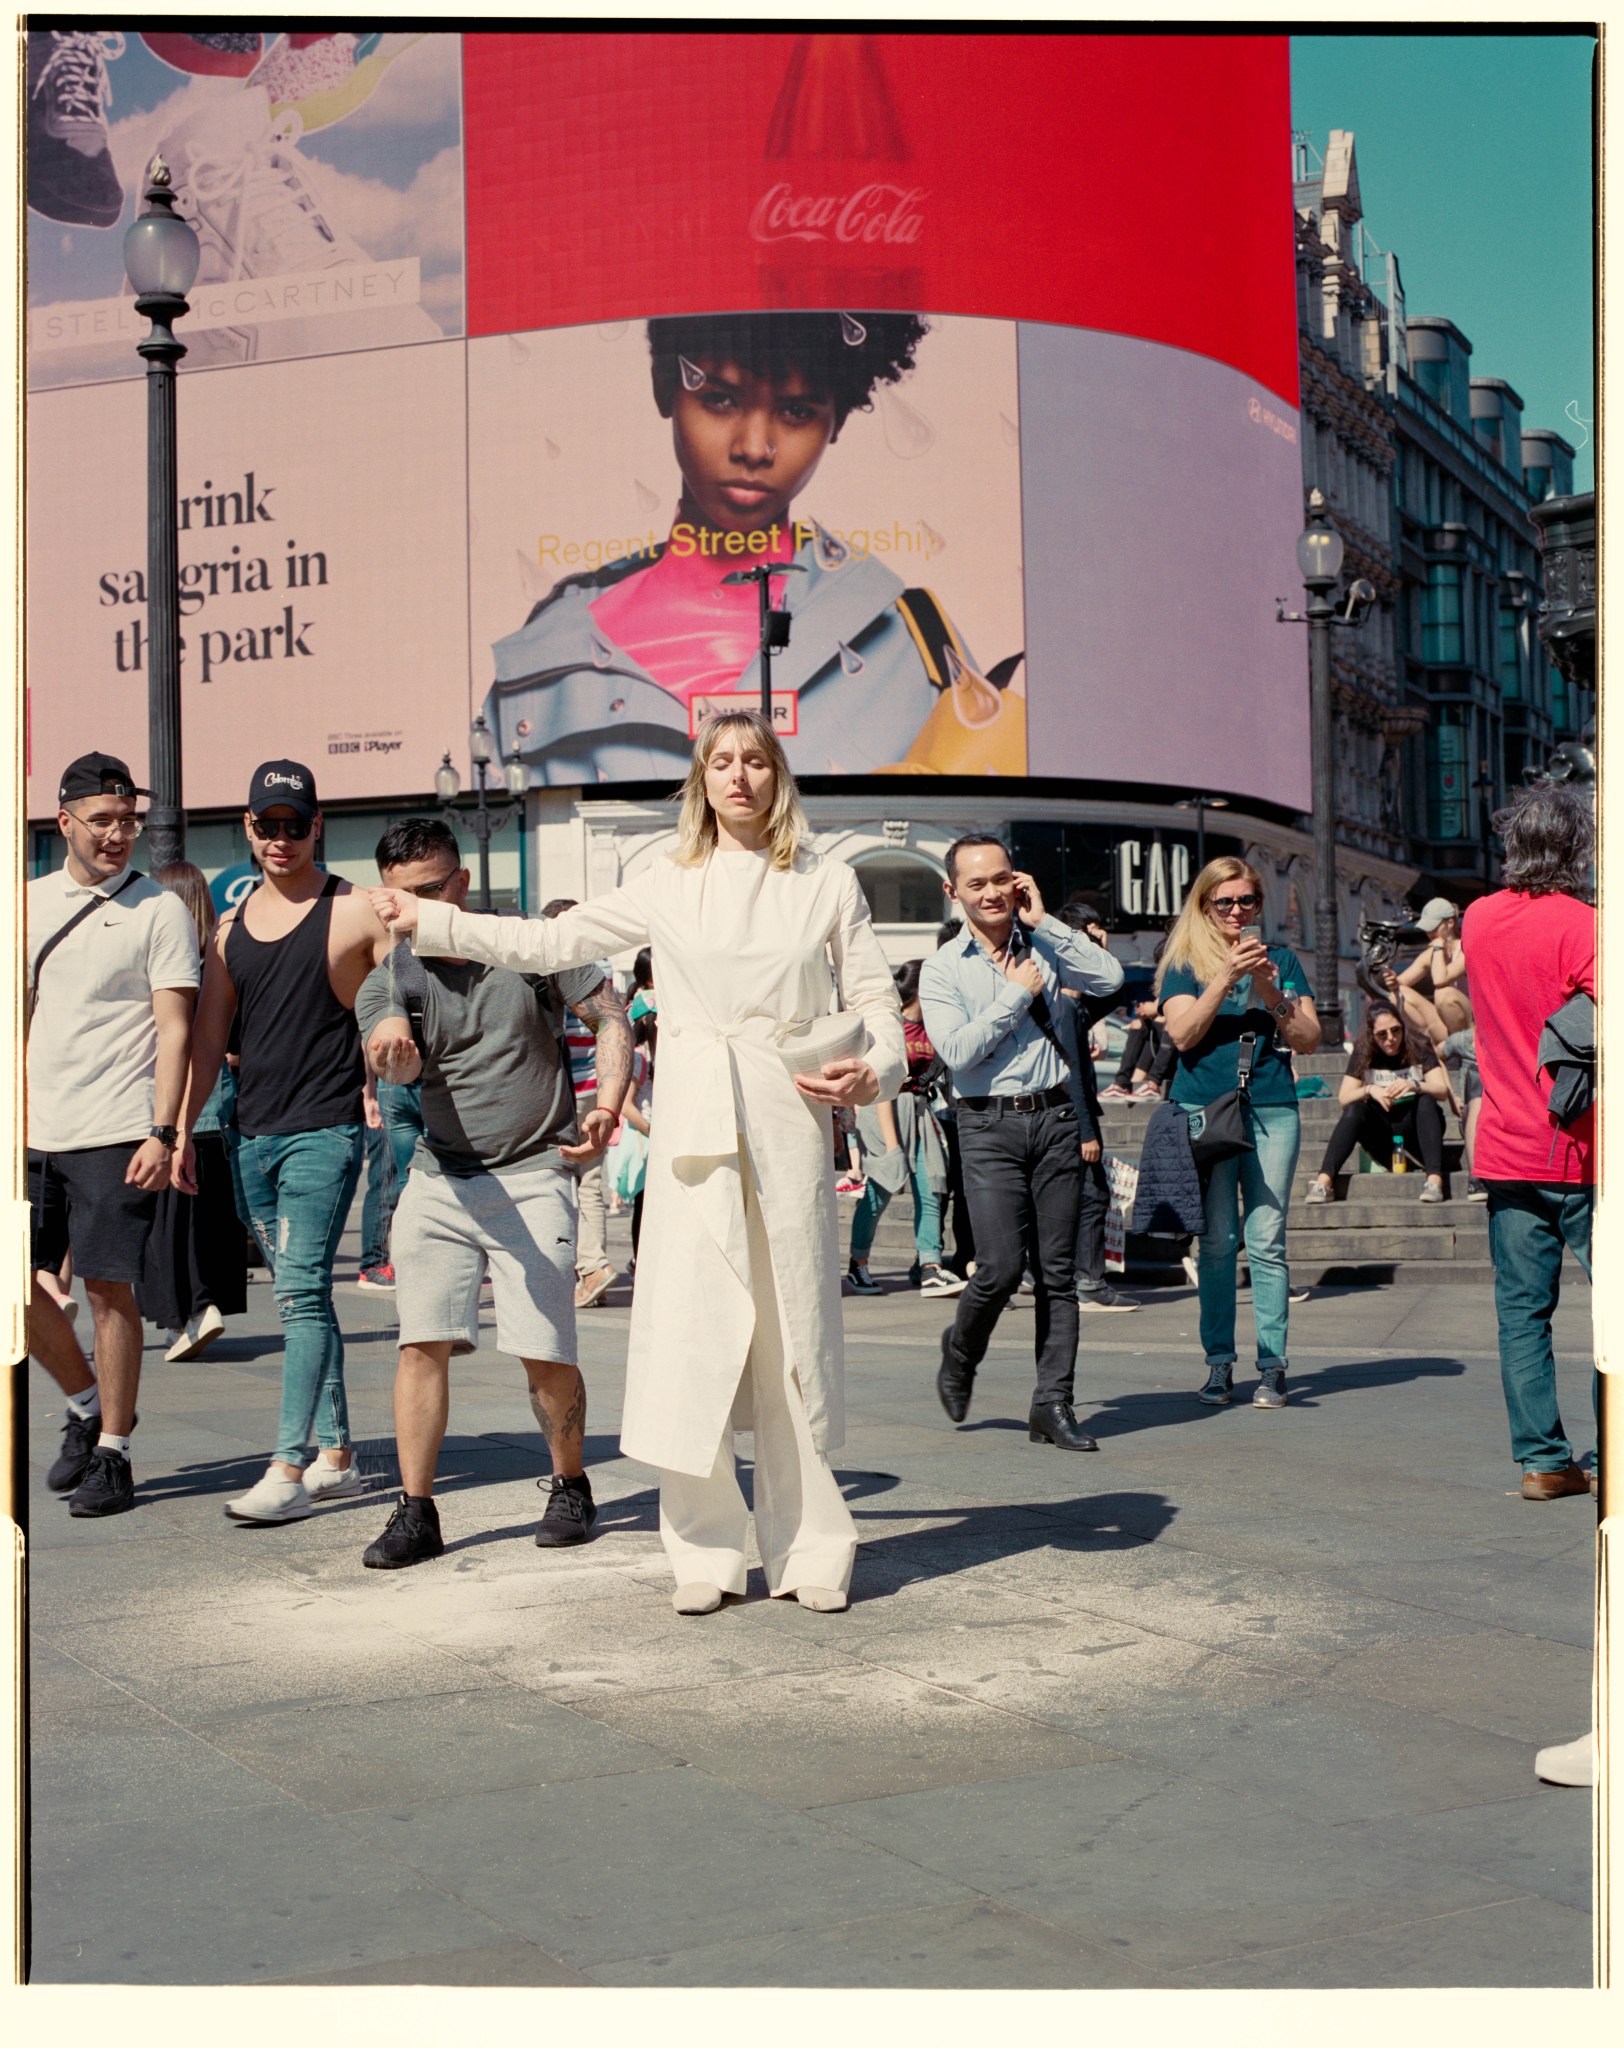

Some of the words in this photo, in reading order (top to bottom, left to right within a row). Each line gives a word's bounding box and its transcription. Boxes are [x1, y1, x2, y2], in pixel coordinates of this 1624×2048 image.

[749, 182, 931, 243] Coca-Cola
[46, 307, 150, 339] STELL
[177, 471, 276, 531] rink
[538, 528, 659, 570] Regent
[670, 523, 782, 557] Street
[795, 521, 941, 560] Fgshi
[99, 545, 273, 617] sagria
[286, 539, 329, 589] in
[200, 604, 316, 683] park
[1120, 840, 1189, 915] GAP
